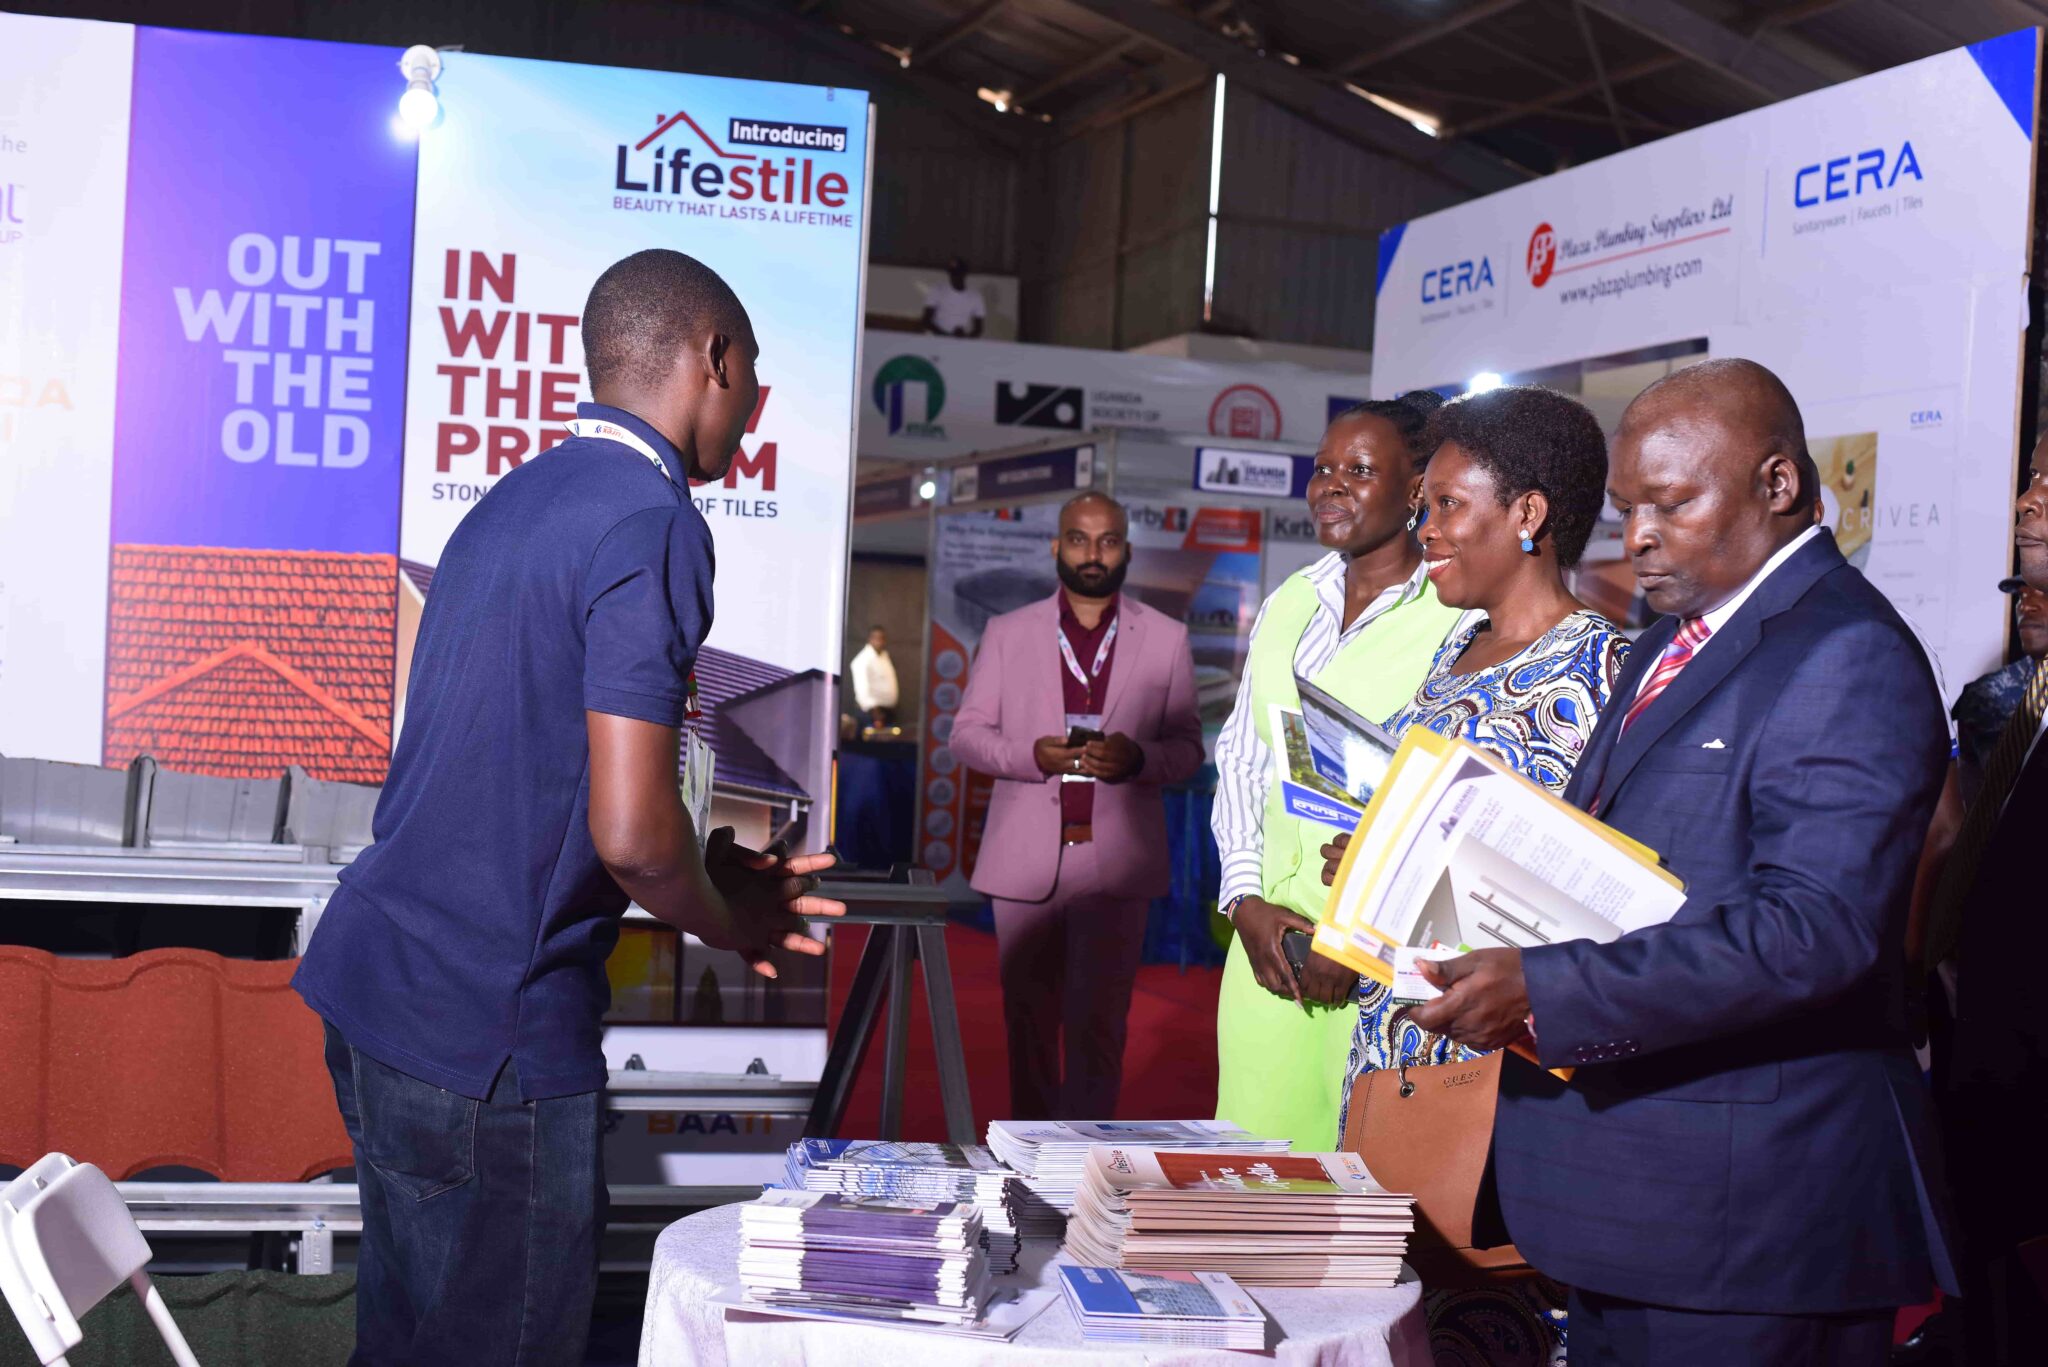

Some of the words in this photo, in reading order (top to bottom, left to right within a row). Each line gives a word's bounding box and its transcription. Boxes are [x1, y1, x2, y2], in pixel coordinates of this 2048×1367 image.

[732, 121, 846, 152] Introducing
[616, 144, 849, 207] Lifestile
[1795, 140, 1923, 208] CERA
[613, 196, 673, 213] BEAUTY
[677, 200, 716, 218] THAT
[719, 205, 767, 221] LASTS
[770, 209, 781, 222] A
[784, 211, 853, 228] LIFETIME
[1594, 221, 1646, 251] Plumbing
[1649, 205, 1705, 238] Suppliers
[1710, 195, 1734, 221] Ltd
[228, 232, 381, 294] OUT
[444, 249, 516, 303] IN
[1422, 255, 1494, 304] CERA
[1560, 257, 1703, 305] www.plazaplumbing.com
[173, 287, 375, 353] WITH
[438, 306, 580, 365] WIT
[223, 349, 373, 411] THE
[437, 364, 581, 422] THE
[220, 409, 371, 469] OLD
[1910, 410, 1942, 425] CERA
[432, 482, 488, 501] STON
[723, 499, 778, 518] TILES
[1274, 515, 1316, 537] Kirb
[1842, 504, 1940, 531] CRIVEA
[1443, 1070, 1480, 1085] GUESS
